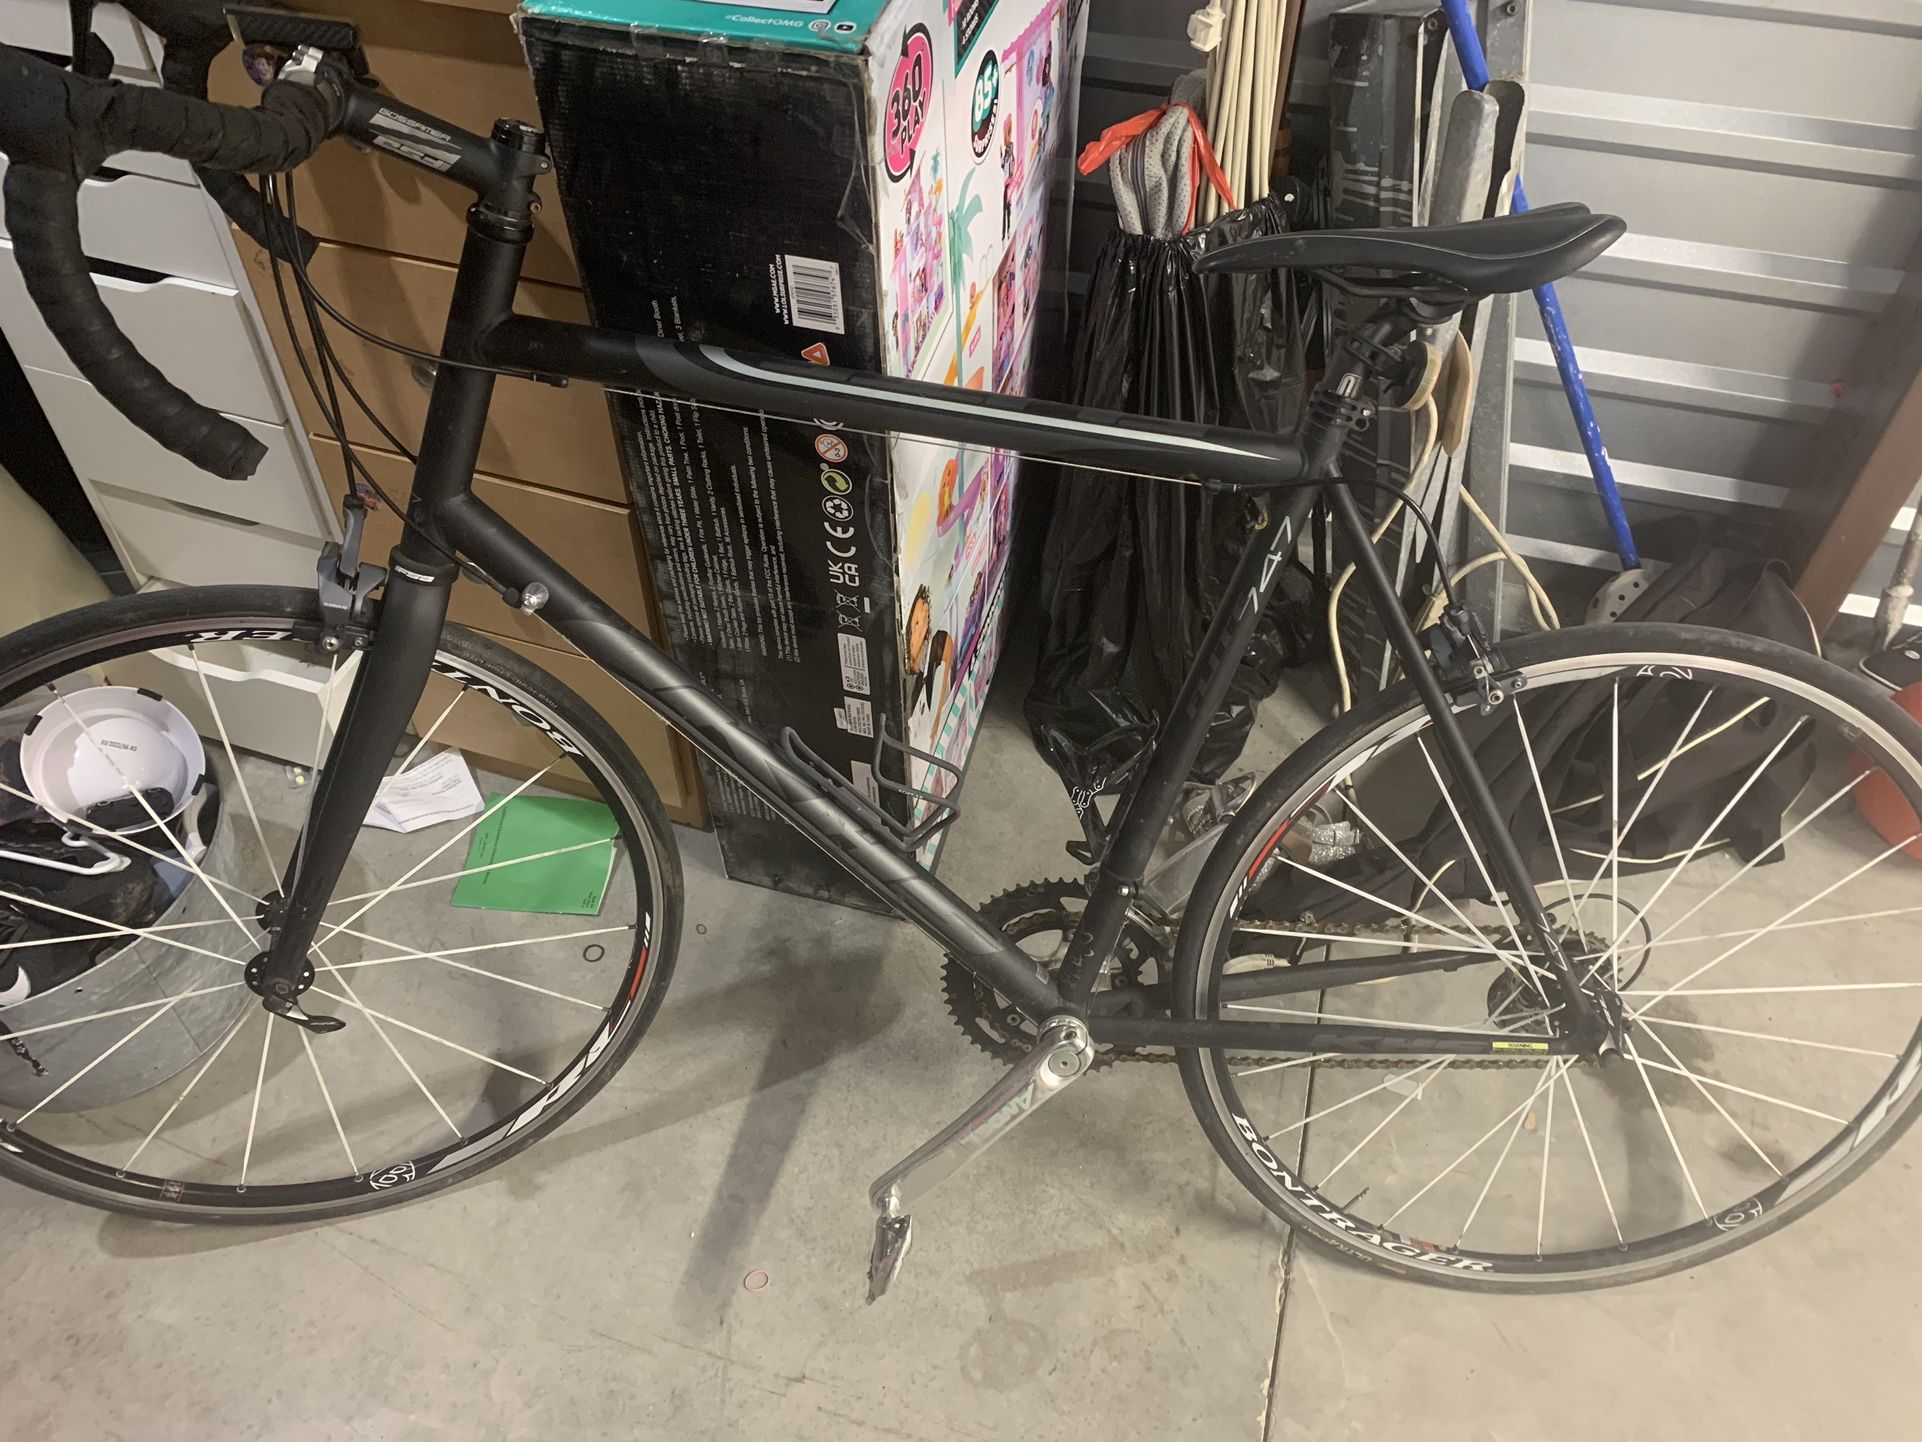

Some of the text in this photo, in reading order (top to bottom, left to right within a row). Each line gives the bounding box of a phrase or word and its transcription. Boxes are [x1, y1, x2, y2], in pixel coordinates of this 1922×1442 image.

[726, 14, 803, 27] #CollectOMG
[892, 53, 922, 143] 360
[975, 61, 998, 122] 85+
[379, 107, 451, 141] GOSSAMER
[901, 88, 926, 157] PLAY
[828, 560, 844, 584] UK
[844, 563, 860, 587] CA
[1232, 1113, 1495, 1273] BONTRAGER
